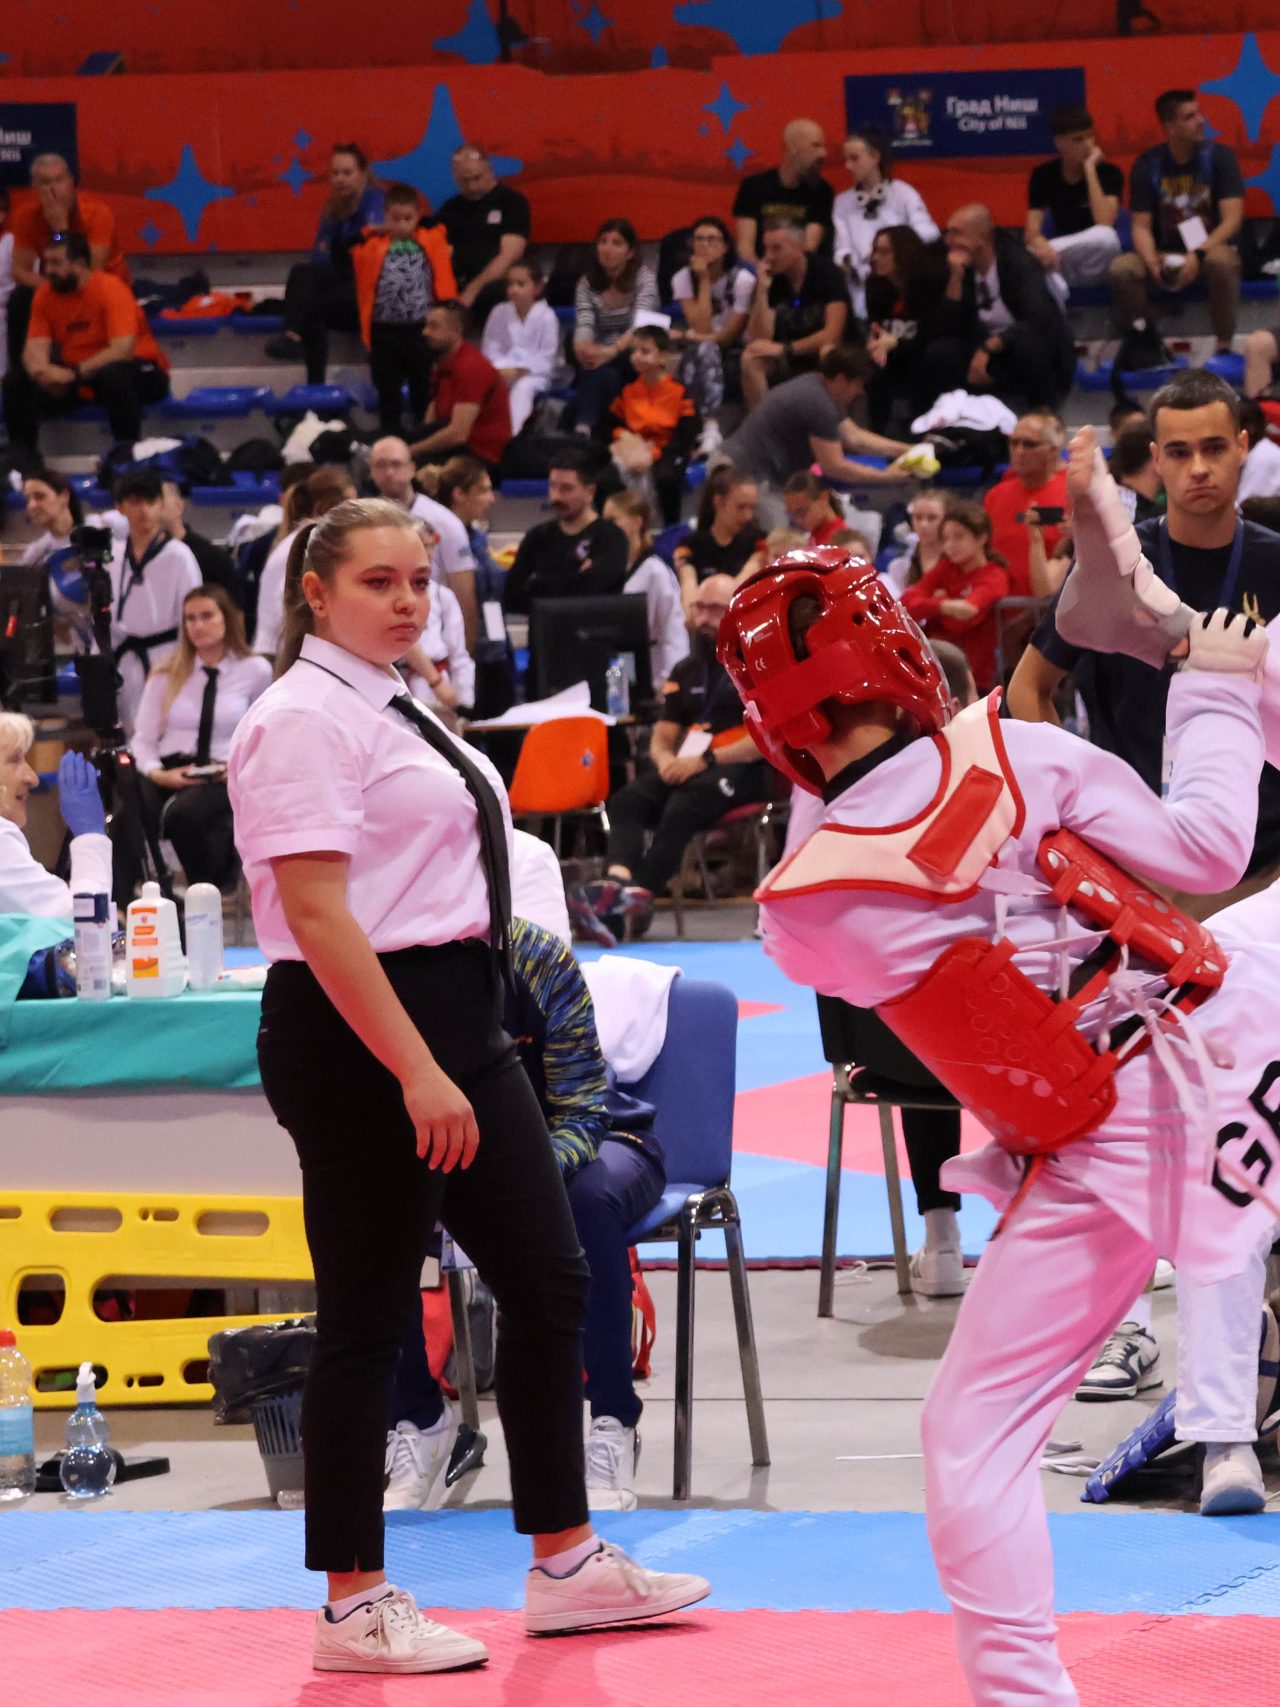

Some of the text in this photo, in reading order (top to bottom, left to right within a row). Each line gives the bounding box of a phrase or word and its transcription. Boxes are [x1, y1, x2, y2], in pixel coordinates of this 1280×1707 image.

[946, 95, 1038, 118] Град Ниш
[958, 116, 986, 134] City
[988, 116, 1003, 130] of
